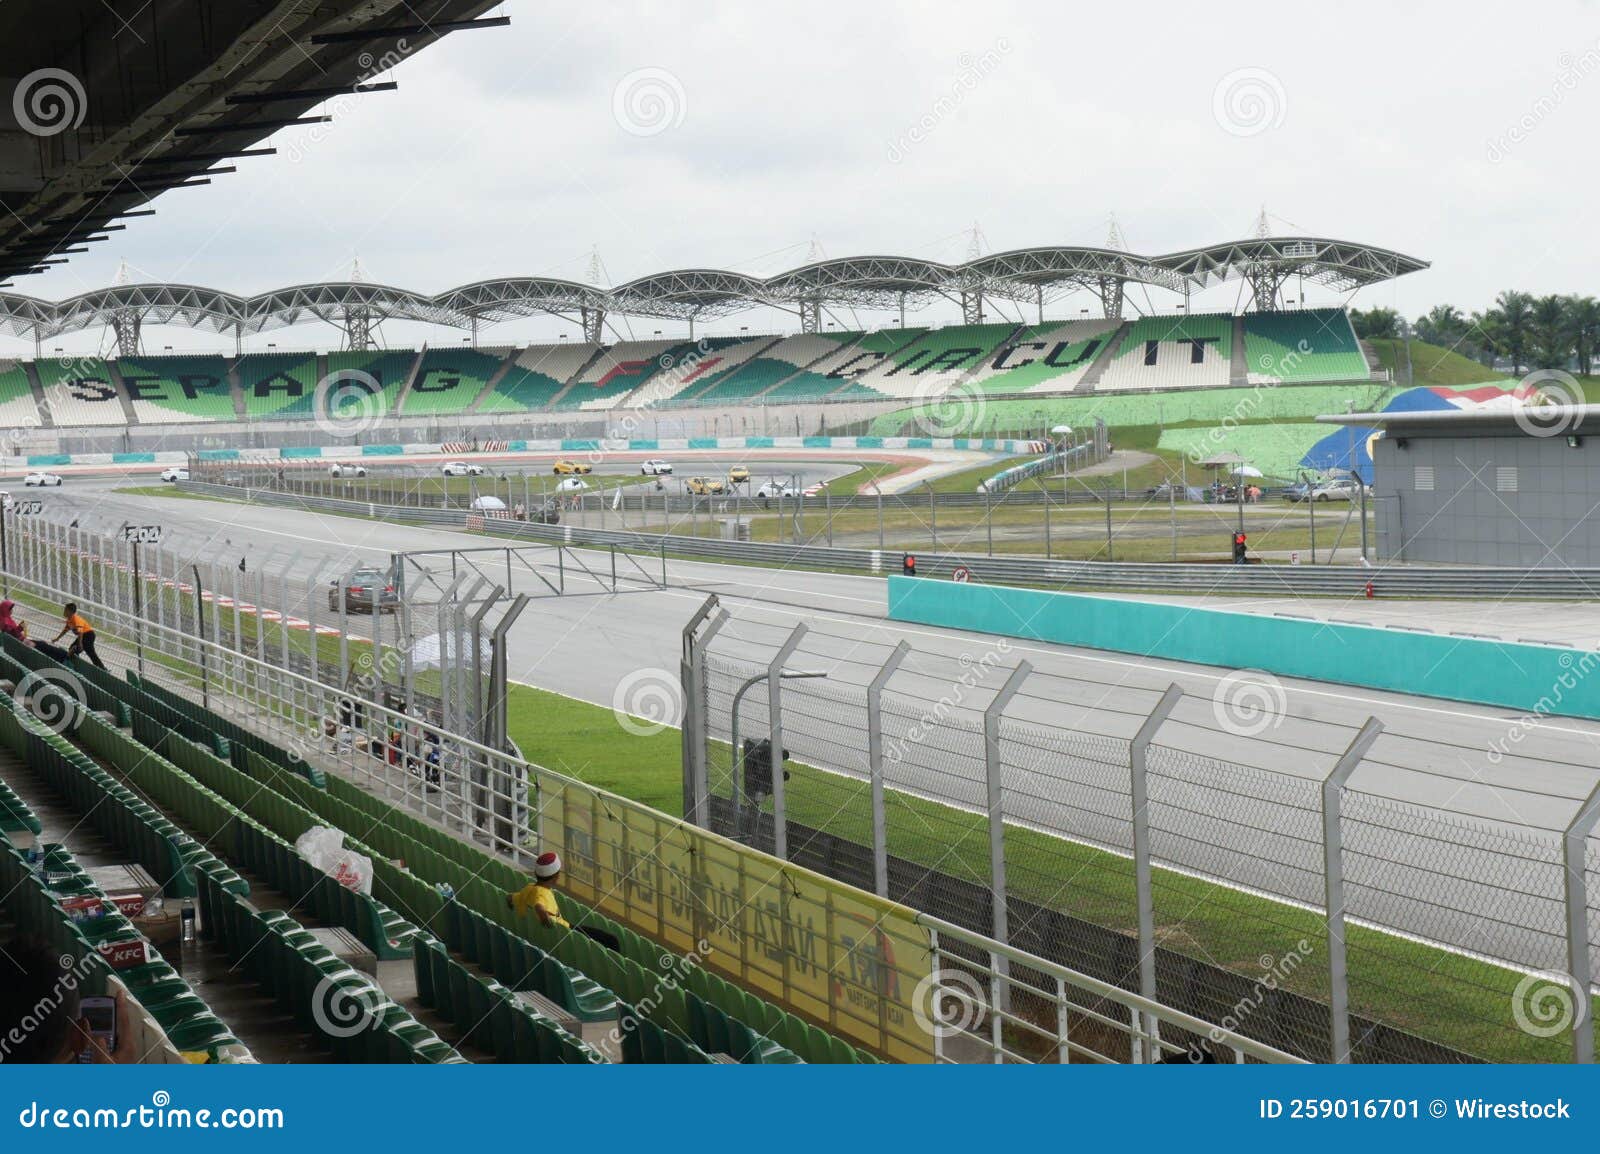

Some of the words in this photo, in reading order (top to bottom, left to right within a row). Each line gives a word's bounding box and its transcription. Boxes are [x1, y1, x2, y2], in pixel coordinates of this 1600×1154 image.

[826, 337, 1220, 379] CIRCUIT
[119, 902, 142, 911] KFC
[115, 948, 142, 961] KFC
